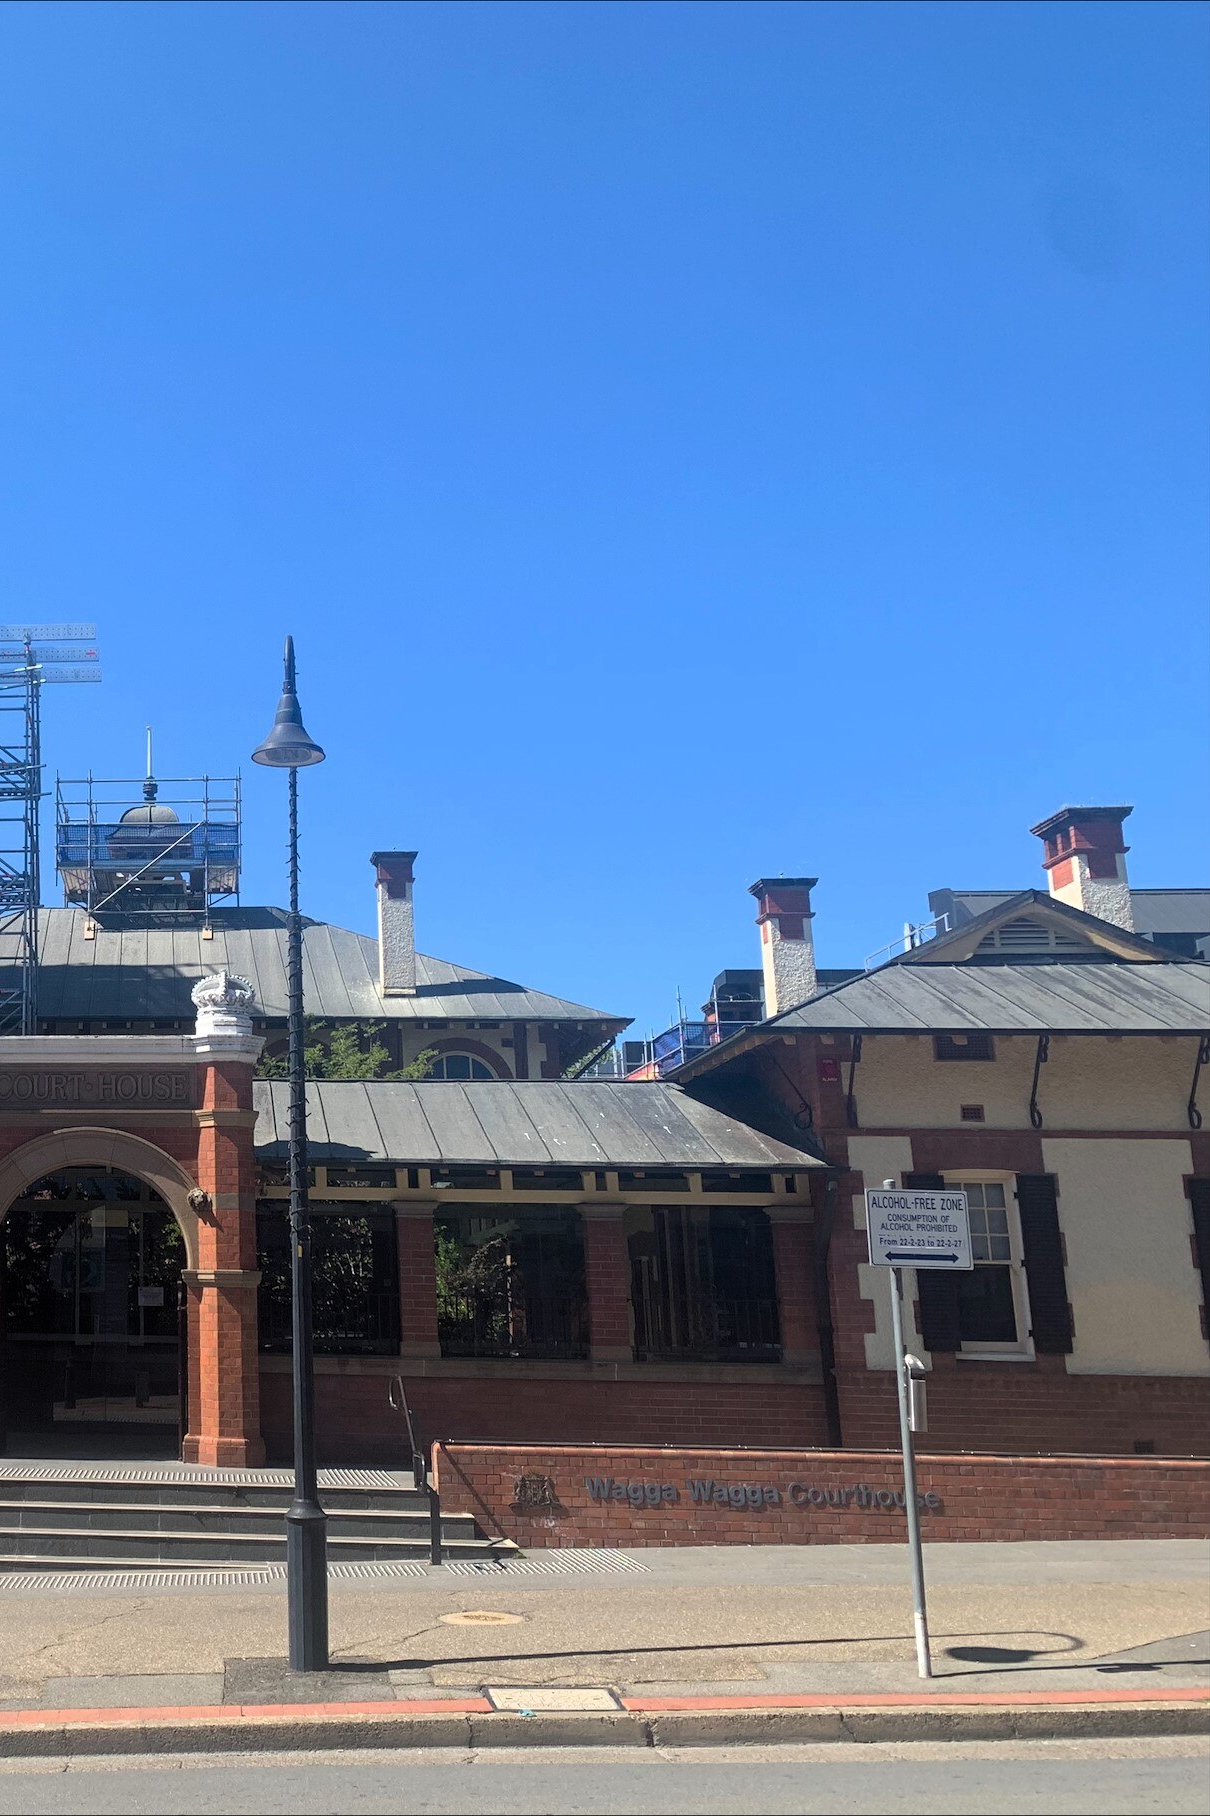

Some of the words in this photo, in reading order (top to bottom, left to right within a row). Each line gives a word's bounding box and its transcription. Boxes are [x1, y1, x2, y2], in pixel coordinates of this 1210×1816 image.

[98, 1074, 187, 1101] HOUSE
[871, 1196, 937, 1210] ALCOHOL-FREE
[940, 1198, 964, 1211] ZONE
[887, 1213, 938, 1223] CONSUMPTION
[940, 1215, 950, 1223] OF
[880, 1222, 914, 1232] ALCOHOL
[916, 1224, 958, 1233] PROHIBITED
[879, 1237, 898, 1246] From
[927, 1239, 935, 1247] to
[584, 1477, 678, 1506] Wagga
[685, 1479, 780, 1508] Wagga
[788, 1482, 941, 1509] Courthouse
